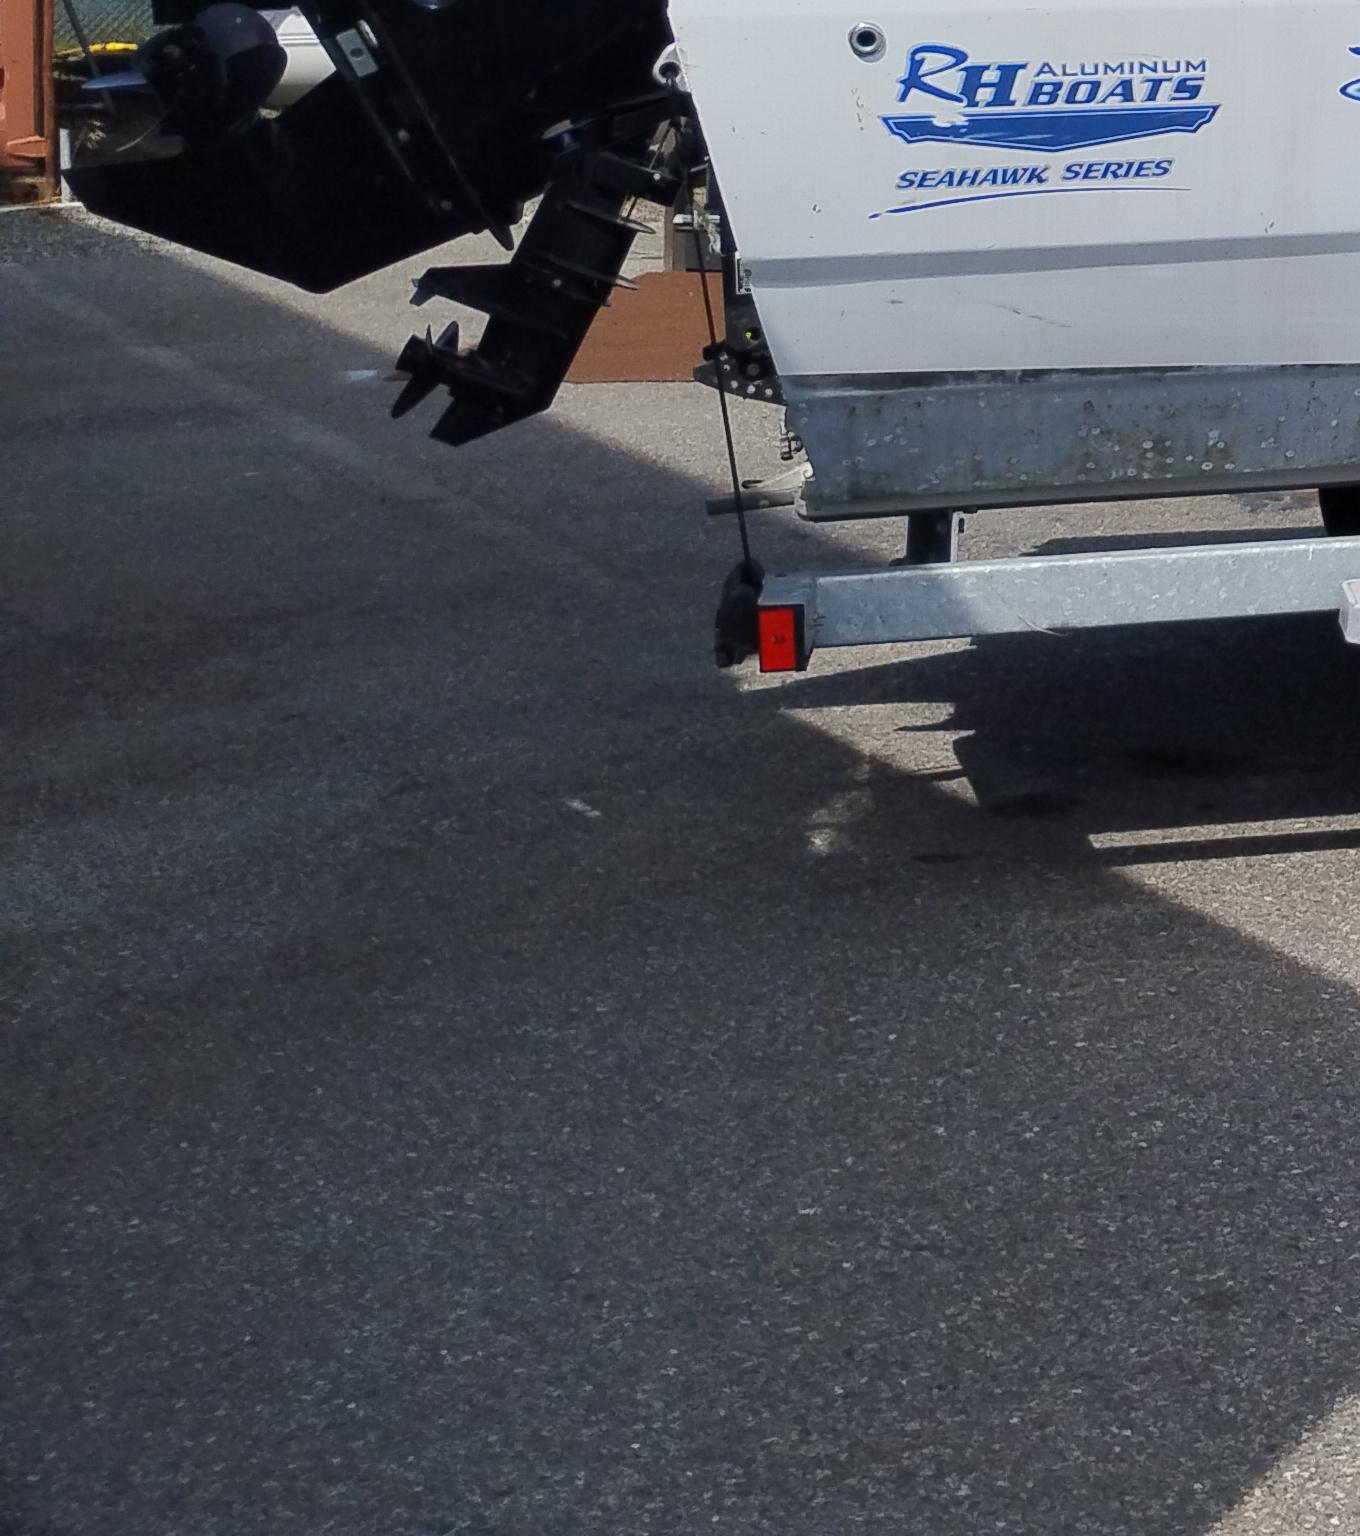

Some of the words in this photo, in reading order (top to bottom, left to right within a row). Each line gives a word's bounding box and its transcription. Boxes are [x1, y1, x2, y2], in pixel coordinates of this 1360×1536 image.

[1035, 60, 1207, 78] ALUMINUM
[1026, 76, 1206, 106] BOATS
[896, 165, 1052, 190] SEAHAWK
[1061, 158, 1174, 180] SERIES
